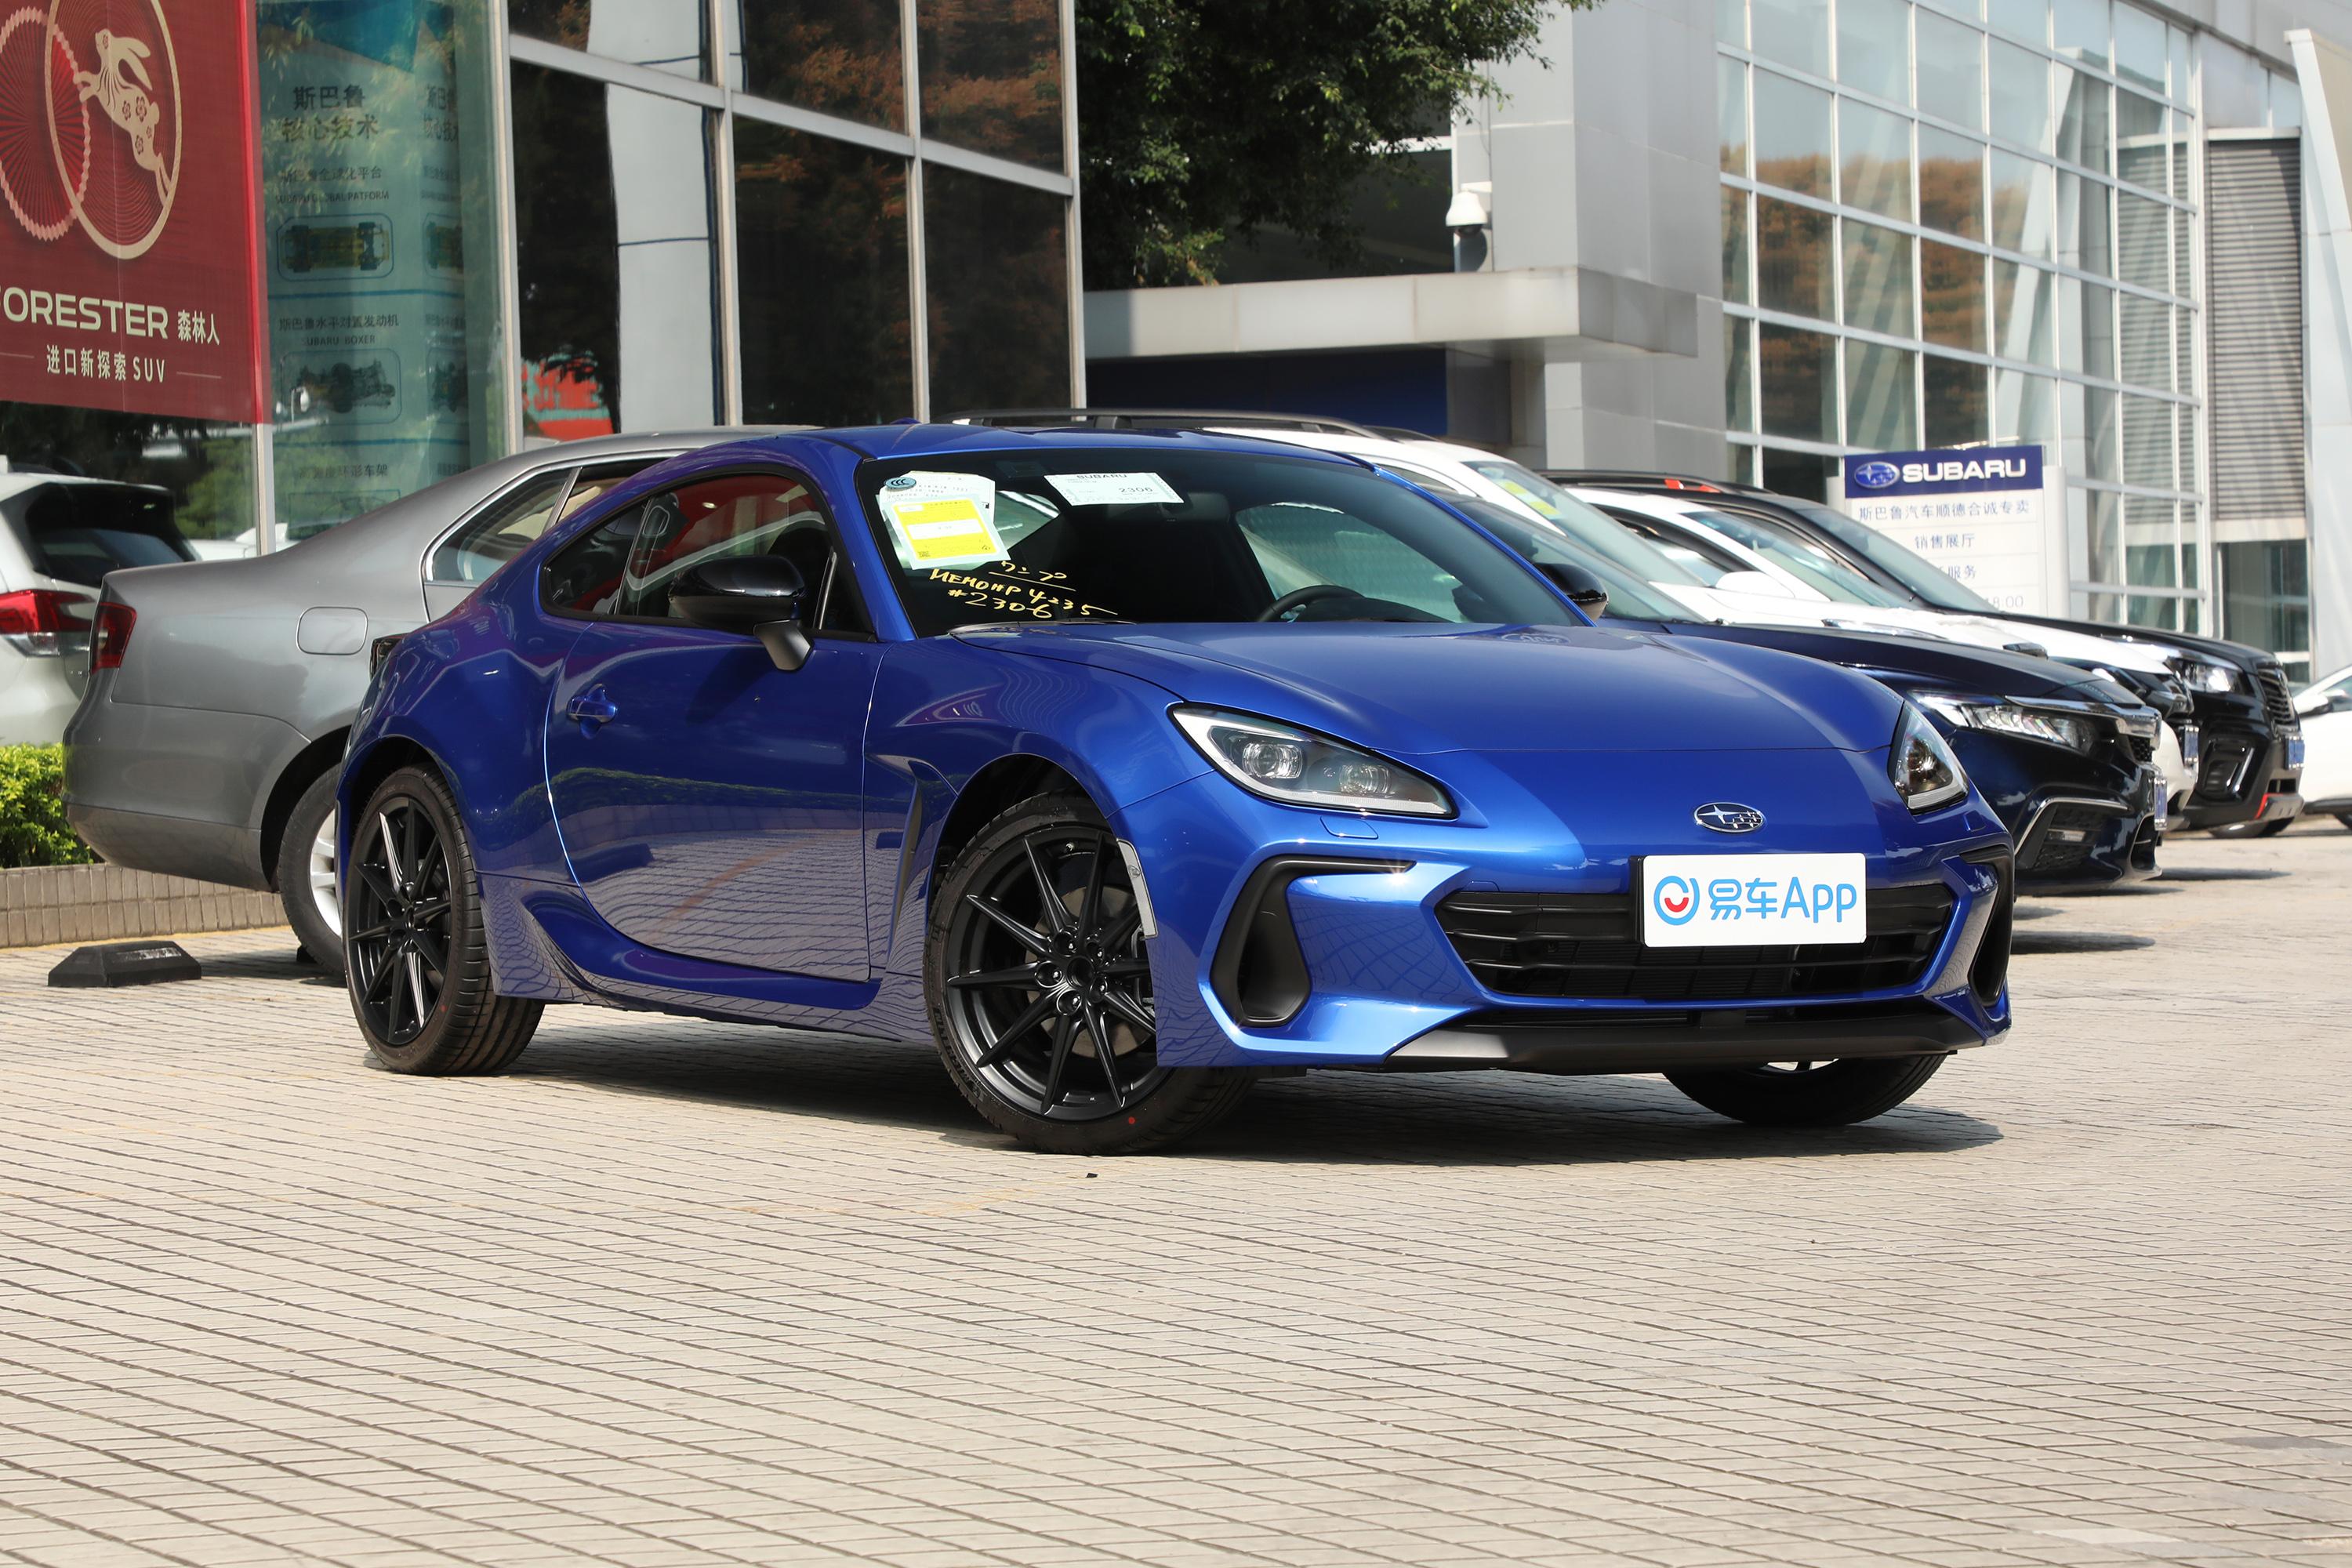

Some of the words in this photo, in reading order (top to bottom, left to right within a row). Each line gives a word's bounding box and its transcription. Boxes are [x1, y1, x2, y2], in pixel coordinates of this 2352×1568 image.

[292, 84, 365, 111] 斯巴鲁
[281, 114, 379, 143] 核心技术
[347, 191, 390, 201] PATFORM
[0, 284, 169, 339] ORESTER
[279, 314, 400, 331] 斯巴鲁水平对置发动机
[177, 309, 220, 346] 森林人
[344, 336, 376, 346] BOXER
[1902, 458, 2027, 483] SUBARU
[1859, 499, 2030, 522] 斯巴鲁汽车顺德合诚专卖
[1915, 532, 1976, 550] 销售展厅
[947, 589, 1053, 619] #2306
[1708, 876, 1857, 924] 易车App
